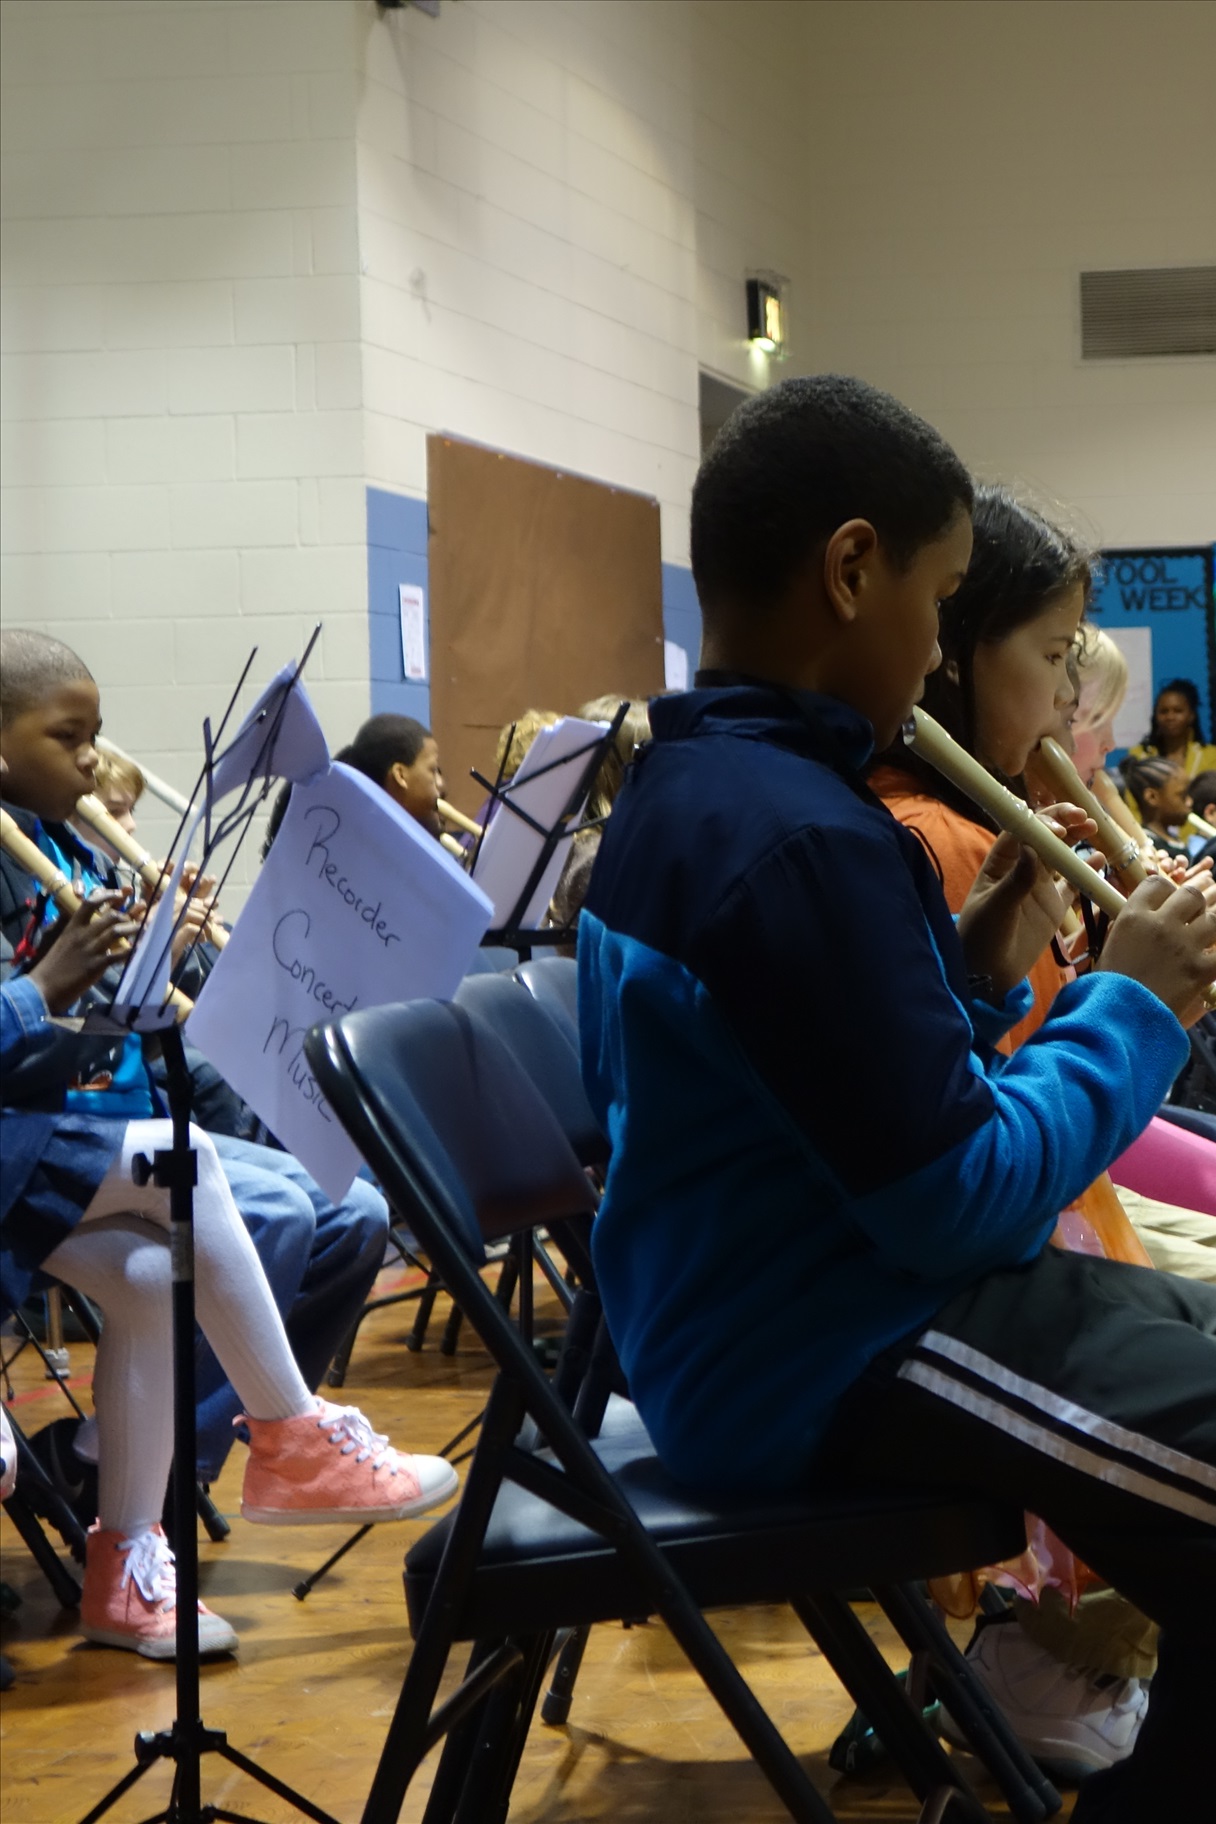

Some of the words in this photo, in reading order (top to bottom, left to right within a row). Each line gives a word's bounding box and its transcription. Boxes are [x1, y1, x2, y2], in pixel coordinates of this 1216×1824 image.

[1119, 584, 1208, 613] WEEK
[304, 804, 401, 948] Recorder
[262, 1015, 334, 1124] Music
